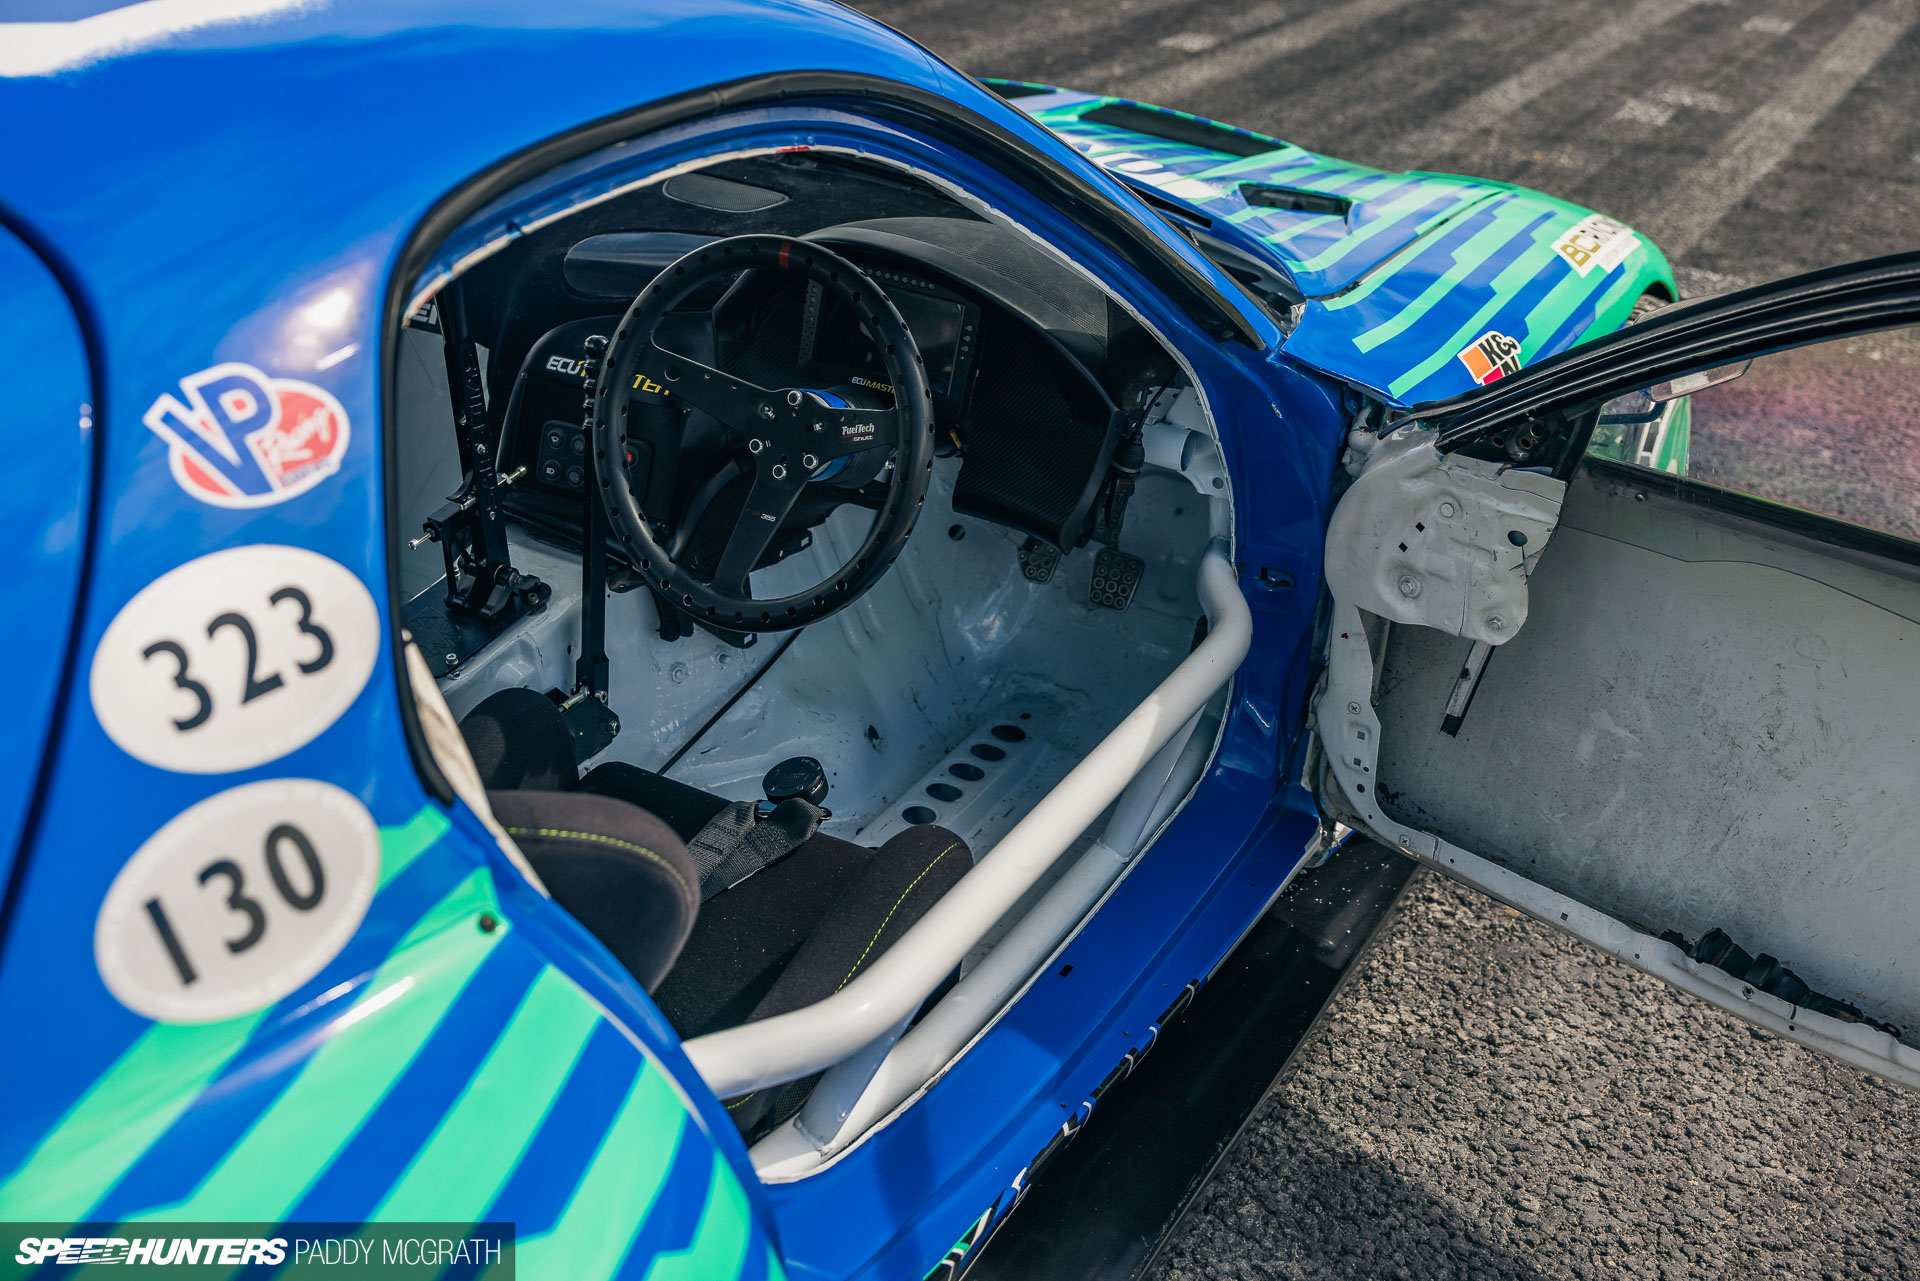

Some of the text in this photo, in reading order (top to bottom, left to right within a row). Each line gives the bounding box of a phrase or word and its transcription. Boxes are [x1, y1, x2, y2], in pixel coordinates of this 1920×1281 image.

[160, 375, 273, 497] VP
[841, 422, 875, 436] FuelTech
[141, 586, 335, 733] 323
[144, 822, 326, 988] 130
